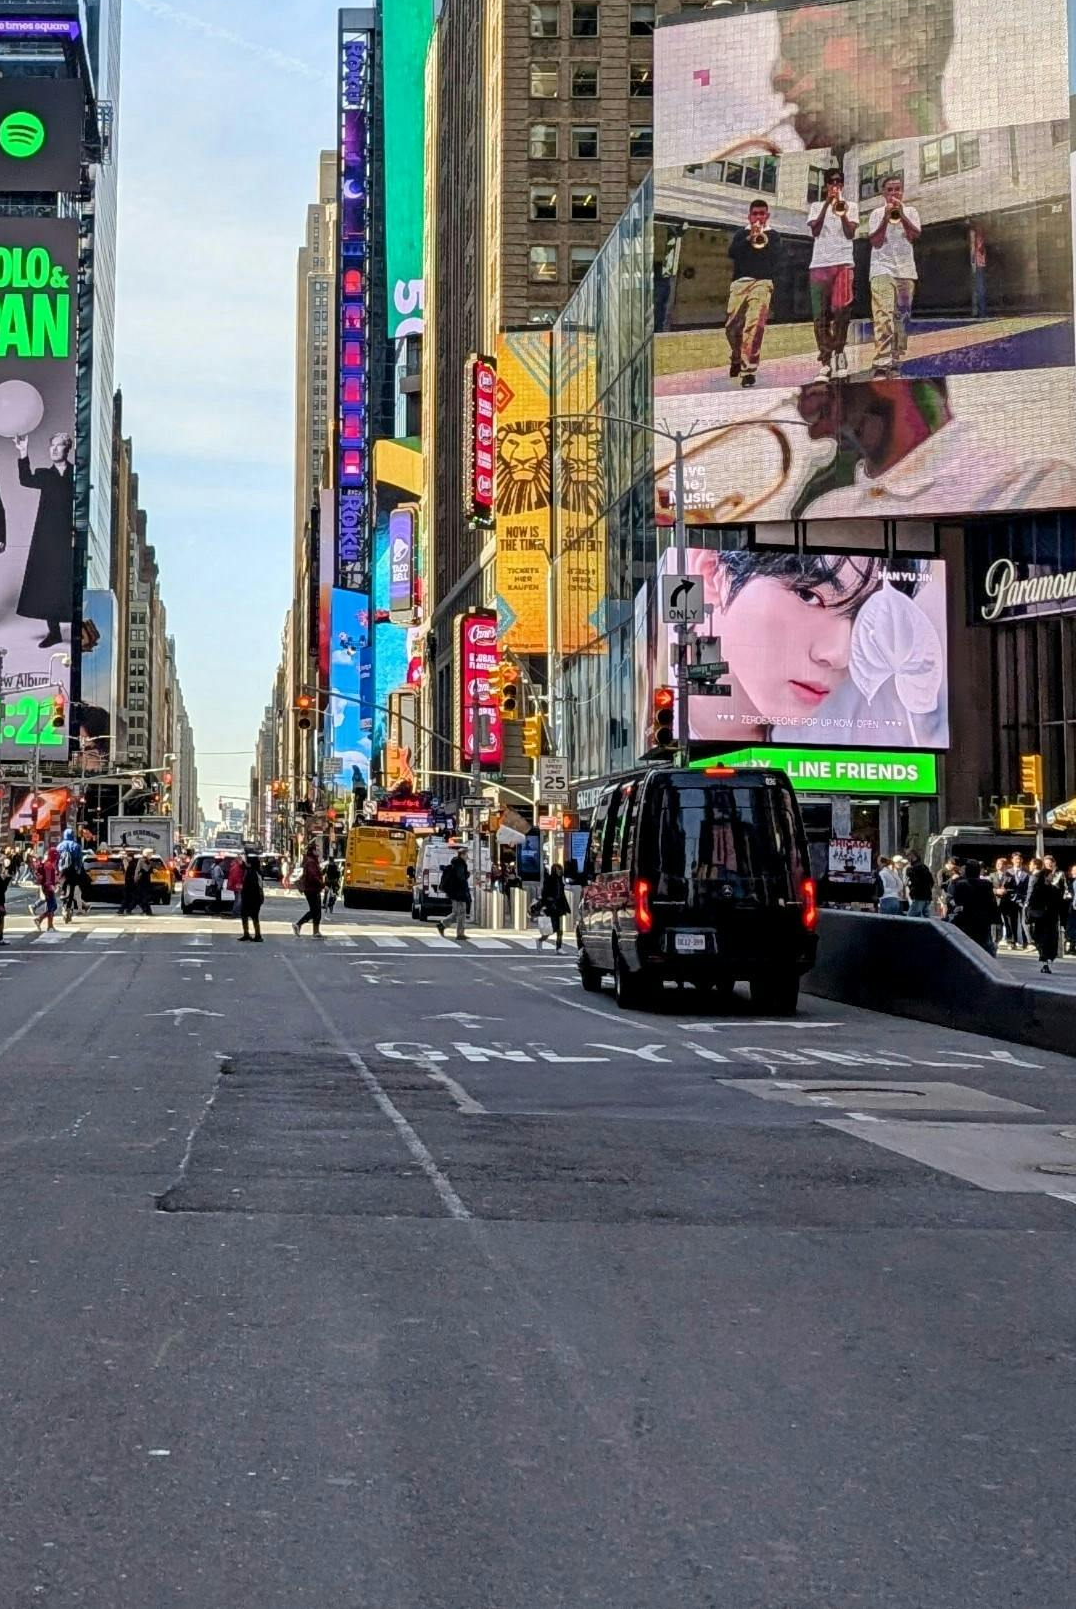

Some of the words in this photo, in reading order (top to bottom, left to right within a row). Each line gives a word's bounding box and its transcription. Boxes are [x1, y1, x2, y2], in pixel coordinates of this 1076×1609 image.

[341, 495, 364, 561] ROKU
[505, 526, 528, 539] NOW
[530, 526, 540, 538] IS
[500, 539, 522, 551] THE
[392, 564, 409, 574] TACO
[393, 573, 409, 583] BELL
[878, 571, 901, 582] HAN
[901, 573, 916, 582] YU
[917, 574, 933, 582] JIN
[669, 610, 698, 620] ONLY
[16, 672, 50, 688] Album
[801, 717, 819, 727] POP
[821, 718, 833, 727] UP
[833, 718, 854, 728] NOW
[856, 720, 880, 729] OPEN
[787, 760, 831, 779] LINE
[835, 762, 919, 782] FRIENDS
[544, 776, 566, 790] 25
[829, 839, 873, 849] CHICAGO
